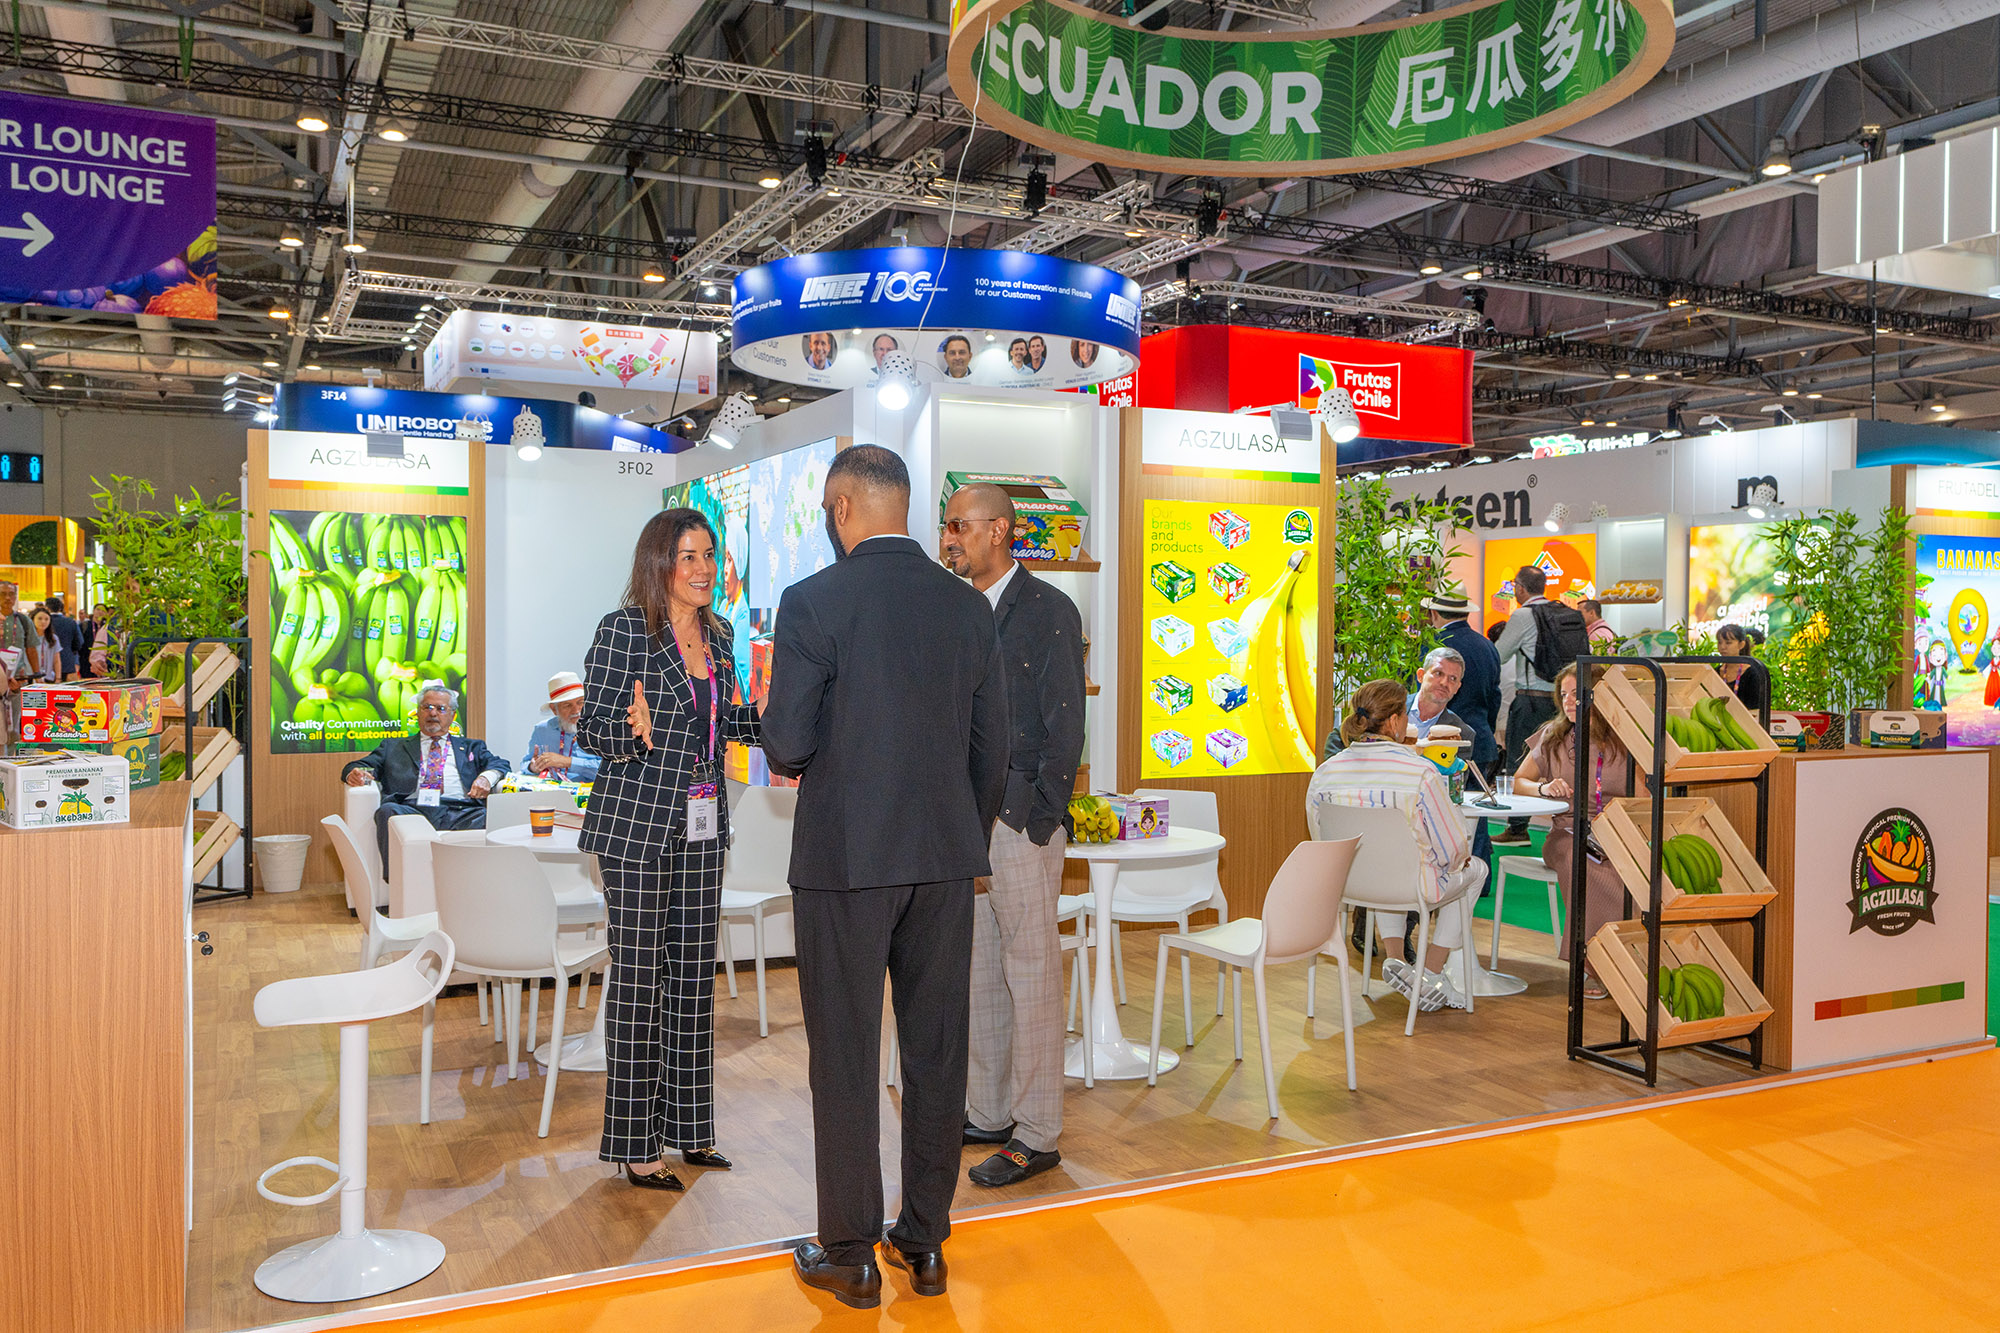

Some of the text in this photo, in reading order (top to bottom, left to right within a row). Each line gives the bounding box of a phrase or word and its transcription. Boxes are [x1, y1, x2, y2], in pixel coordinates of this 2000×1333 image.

[989, 13, 1322, 135] ECUADOR
[34, 123, 187, 167] LOUNGE
[10, 162, 165, 205] LOUNGE
[800, 272, 871, 303] UNITEC
[974, 278, 990, 286] 100
[991, 280, 1012, 288] years
[1013, 281, 1021, 289] of
[1058, 286, 1071, 295] and
[1071, 288, 1093, 300] Results
[1002, 290, 1042, 301] Customers
[752, 347, 787, 367] Customers
[1103, 375, 1133, 395] Frutas
[1344, 369, 1392, 389] Frutas
[321, 390, 347, 401] 3F14
[1108, 391, 1133, 408] Chile
[1352, 389, 1392, 408] Chile
[356, 413, 494, 434] UNIROBOTS
[1179, 429, 1287, 454] AGZULASA
[617, 460, 654, 475] 3F02
[1938, 479, 1999, 498] FRUTADEL
[1012, 500, 1069, 511] erravera
[1151, 507, 1174, 519] Our
[1151, 518, 1193, 531] brands
[1151, 530, 1174, 541] and
[1151, 541, 1204, 554] products
[1936, 549, 2000, 570] BANANAS
[1727, 596, 1768, 617] social
[43, 729, 89, 738] Kassandra
[123, 719, 153, 734] Kassandra
[280, 719, 402, 732] Quality Commitment
[280, 730, 409, 741] with all our Customers
[1863, 814, 1926, 844] TROPICAL PREMIUM FRUITS
[1855, 851, 1863, 889] ECUADOR
[1861, 888, 1925, 914] AGZULASA
[1877, 912, 1893, 920] FRESH
